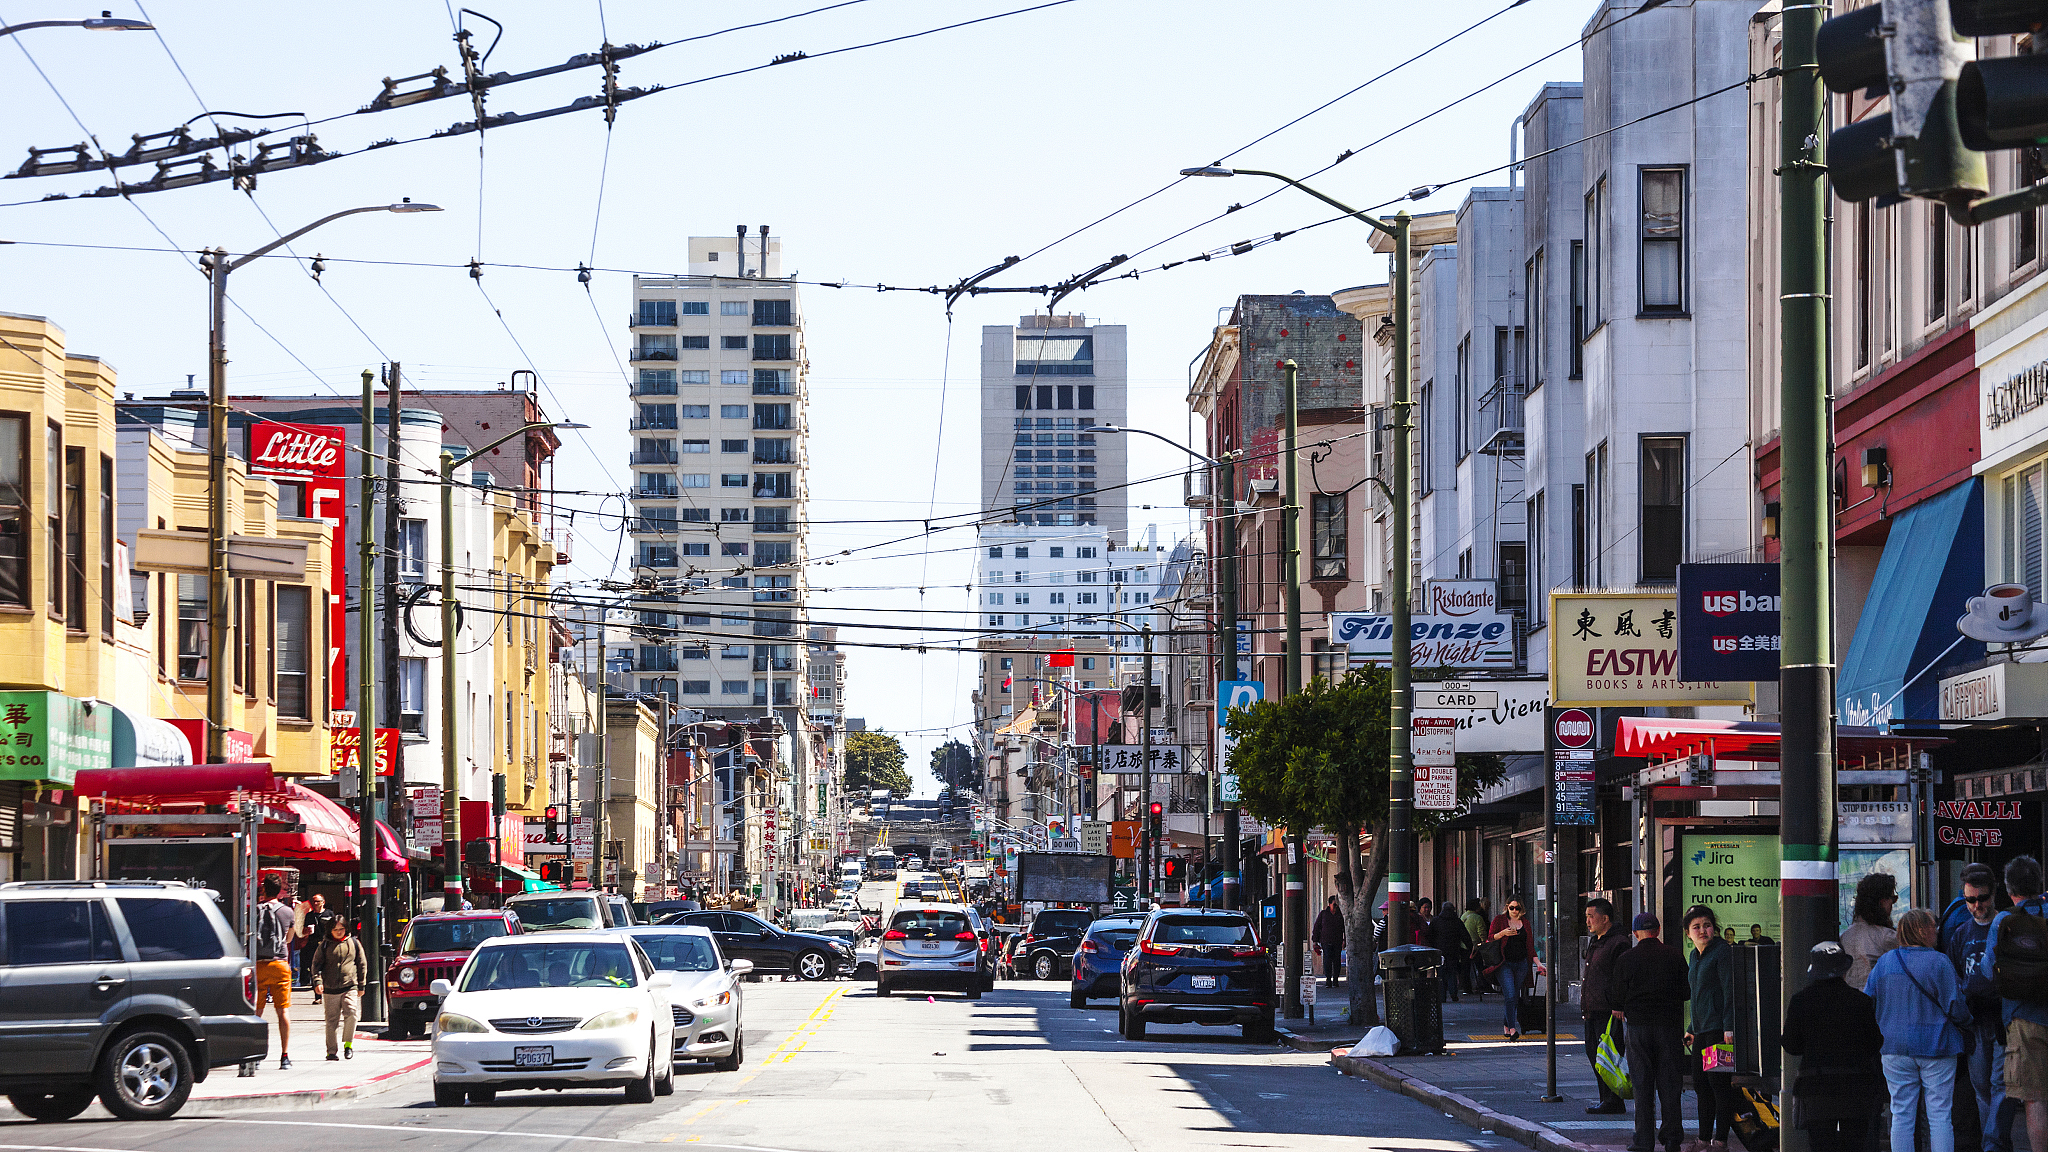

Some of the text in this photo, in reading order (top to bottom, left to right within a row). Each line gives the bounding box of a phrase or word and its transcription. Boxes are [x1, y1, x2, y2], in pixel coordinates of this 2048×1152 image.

[256, 431, 337, 466] Little
[1432, 584, 1494, 617] Ristorante
[1411, 638, 1498, 666] By Night
[1586, 680, 1628, 690] BOOKS
[1636, 680, 1644, 690] &
[1437, 694, 1477, 706] CARD
[1414, 726, 1454, 736] NO STOPPING
[1416, 747, 1421, 755] 4
[1437, 747, 1442, 755] 6
[20, 755, 44, 766] CO.
[1416, 768, 1428, 779] NO
[1556, 782, 1566, 791] 30
[1556, 792, 1566, 801] 45
[1557, 802, 1566, 811] 91
[1842, 803, 1909, 812] STOP ID # 16513
[1920, 800, 2021, 819] AVALLI
[1849, 816, 1859, 824] 30
[1865, 816, 1876, 824] 45
[1881, 816, 1891, 824] 91
[1938, 825, 2002, 847] CAFE
[1054, 841, 1076, 849] DO NOT
[1709, 851, 1734, 865] Jira
[187, 876, 207, 888] the
[1691, 875, 1715, 887] The
[1718, 875, 1746, 887] best
[1691, 892, 1757, 904] run on Jira
[516, 1052, 551, 1063] 5PDG377
